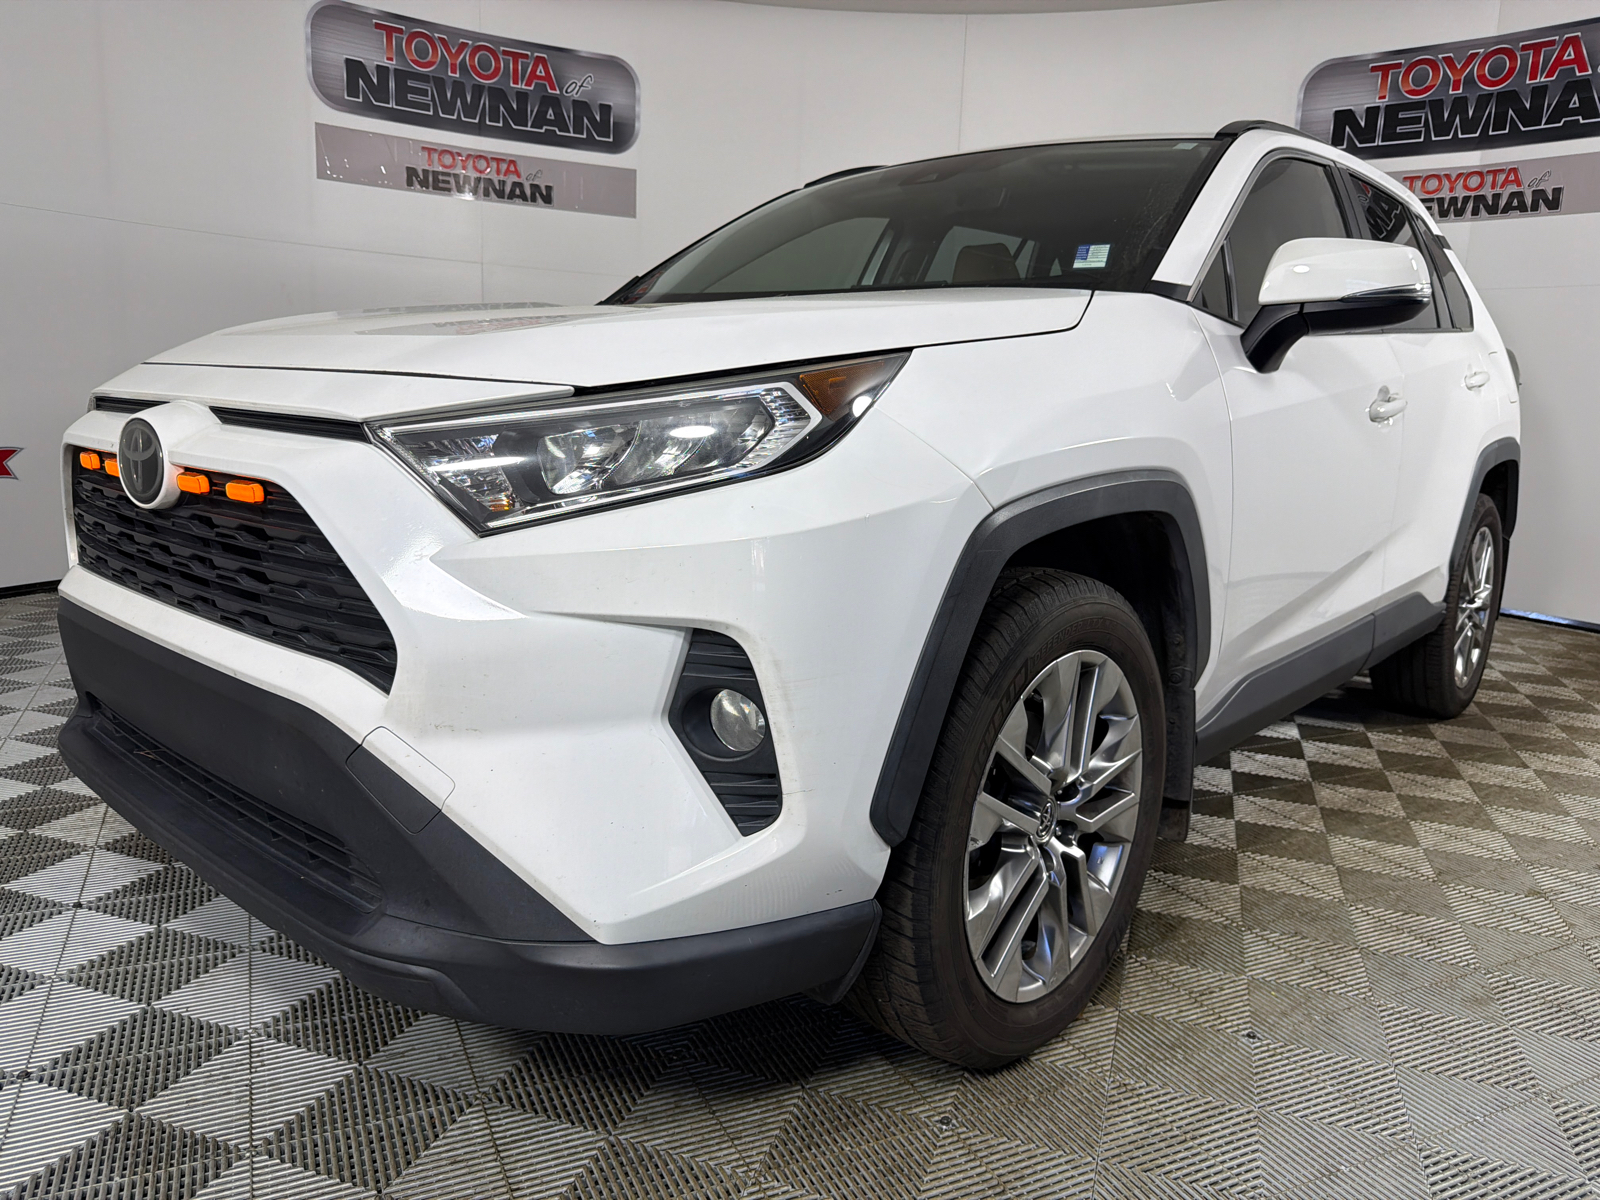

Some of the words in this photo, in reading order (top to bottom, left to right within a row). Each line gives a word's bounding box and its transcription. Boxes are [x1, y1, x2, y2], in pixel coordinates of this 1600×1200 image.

[373, 20, 559, 93] TOYOTA
[563, 74, 594, 96] of
[1370, 32, 1592, 101] TOYOTA
[344, 57, 613, 142] NEWNAN
[1331, 77, 1600, 148] NEWNA
[405, 166, 554, 205] NEWNAN
[421, 146, 522, 179] TOYOTA
[526, 170, 542, 182] of
[1402, 166, 1523, 195] TOYOTA
[1527, 171, 1551, 188] of
[1420, 186, 1564, 220] EWNAN
[1034, 621, 1083, 665] DEFENDER
